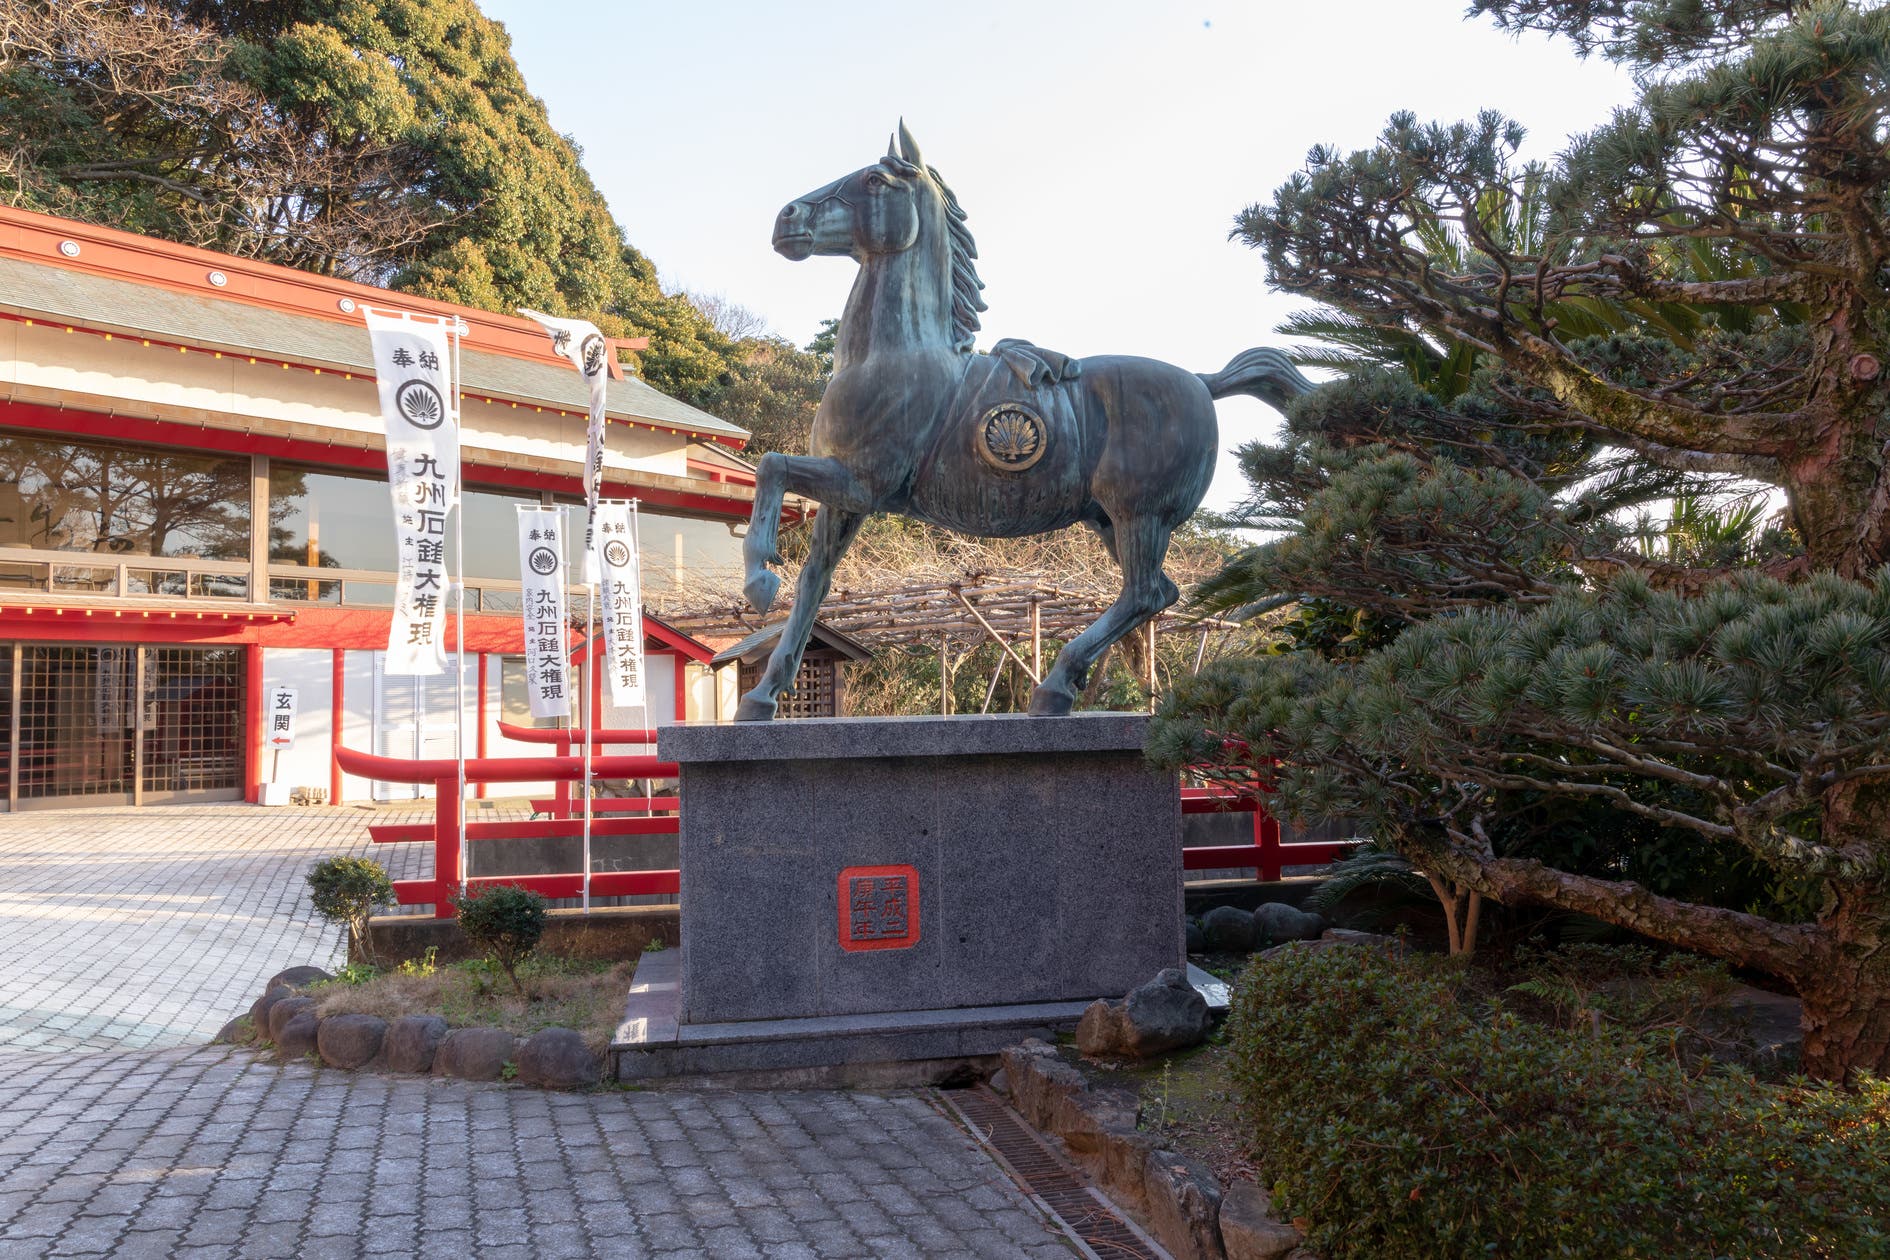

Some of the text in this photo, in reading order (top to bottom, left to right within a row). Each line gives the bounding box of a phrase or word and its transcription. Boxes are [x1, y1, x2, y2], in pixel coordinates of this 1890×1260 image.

[392, 347, 439, 371] 奉納
[528, 528, 556, 541] 奉納
[602, 522, 626, 534] 奉納
[536, 589, 564, 699] 九州石鎚大権現
[274, 692, 293, 732] 玄関
[880, 877, 905, 935] 平成二
